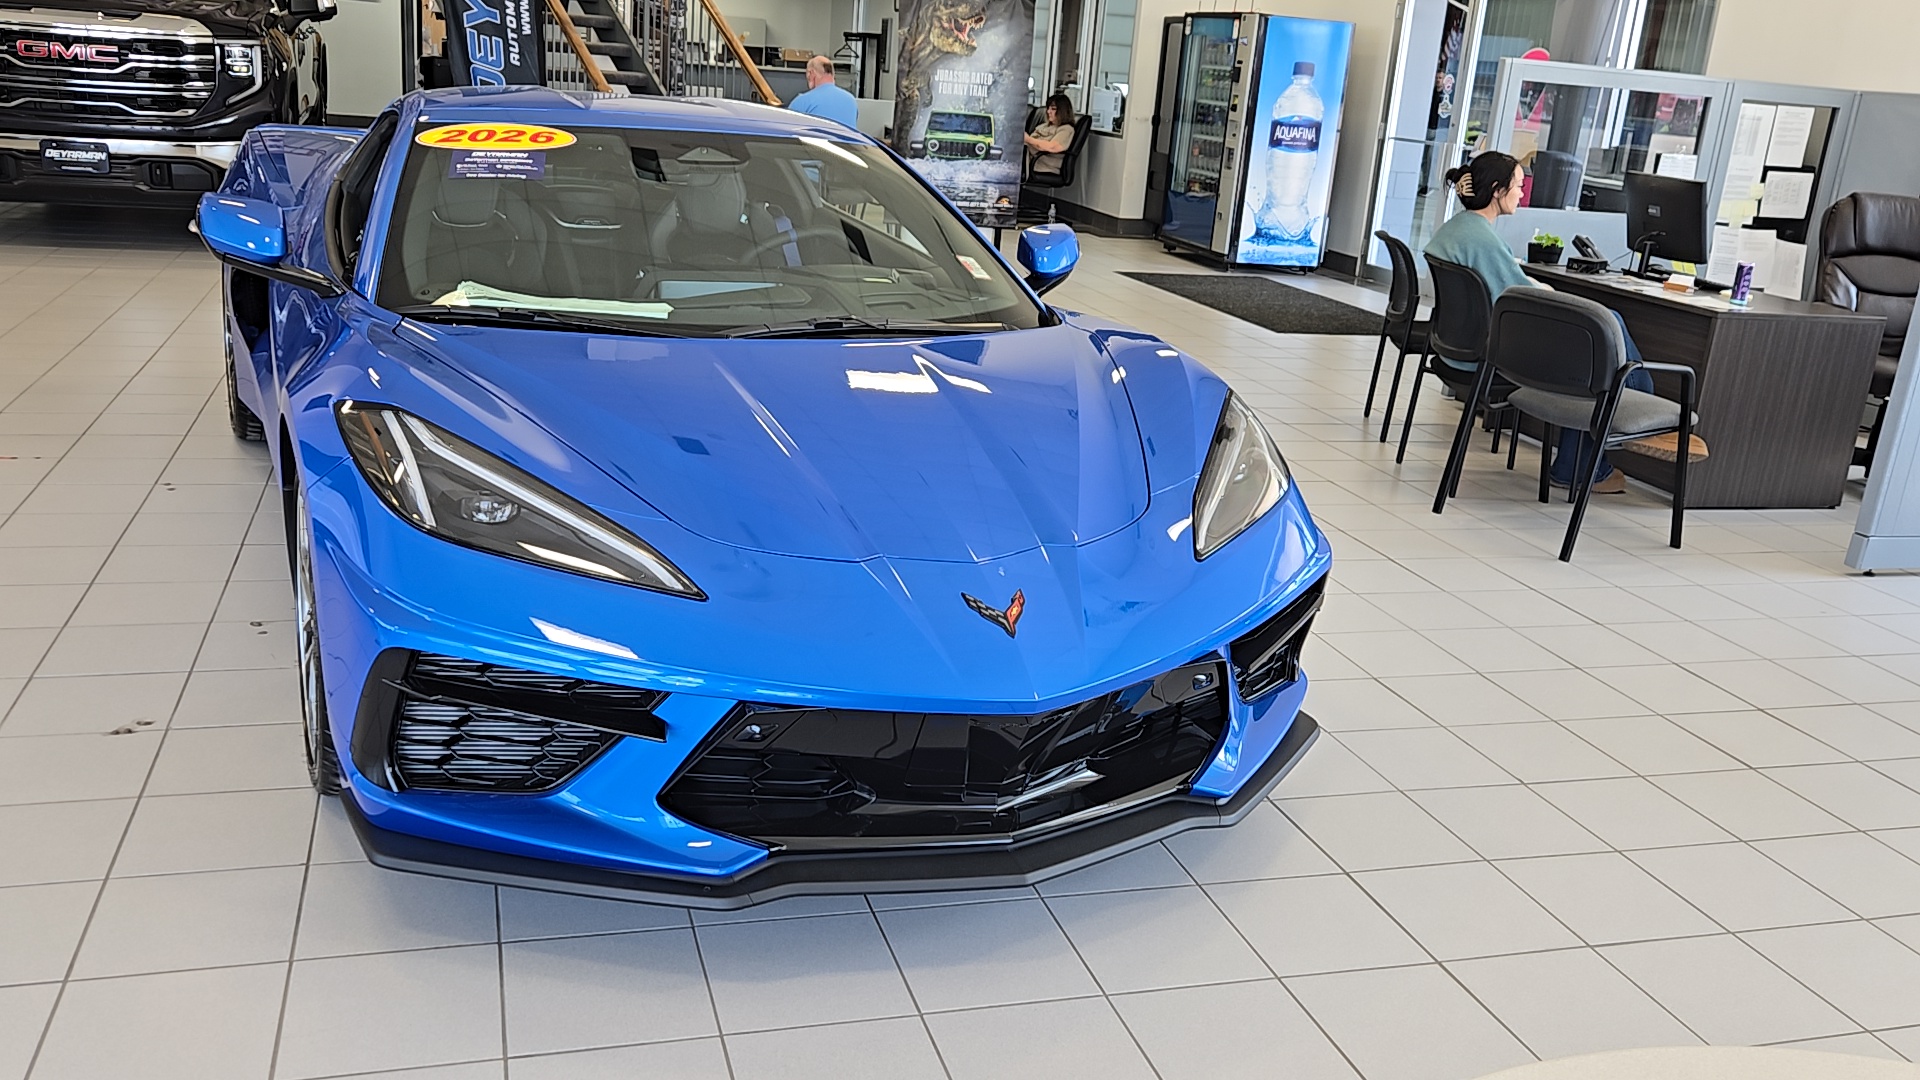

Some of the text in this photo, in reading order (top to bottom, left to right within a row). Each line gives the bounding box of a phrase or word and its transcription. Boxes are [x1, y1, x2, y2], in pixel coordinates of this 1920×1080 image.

[16, 40, 119, 63] GMC
[934, 69, 993, 86] JURASSIC RATED
[938, 82, 988, 97] FOR ANY TRAIL
[434, 129, 558, 144] 2026
[1273, 125, 1316, 143] AQUAFINA
[44, 148, 107, 161] DEYARMAN
